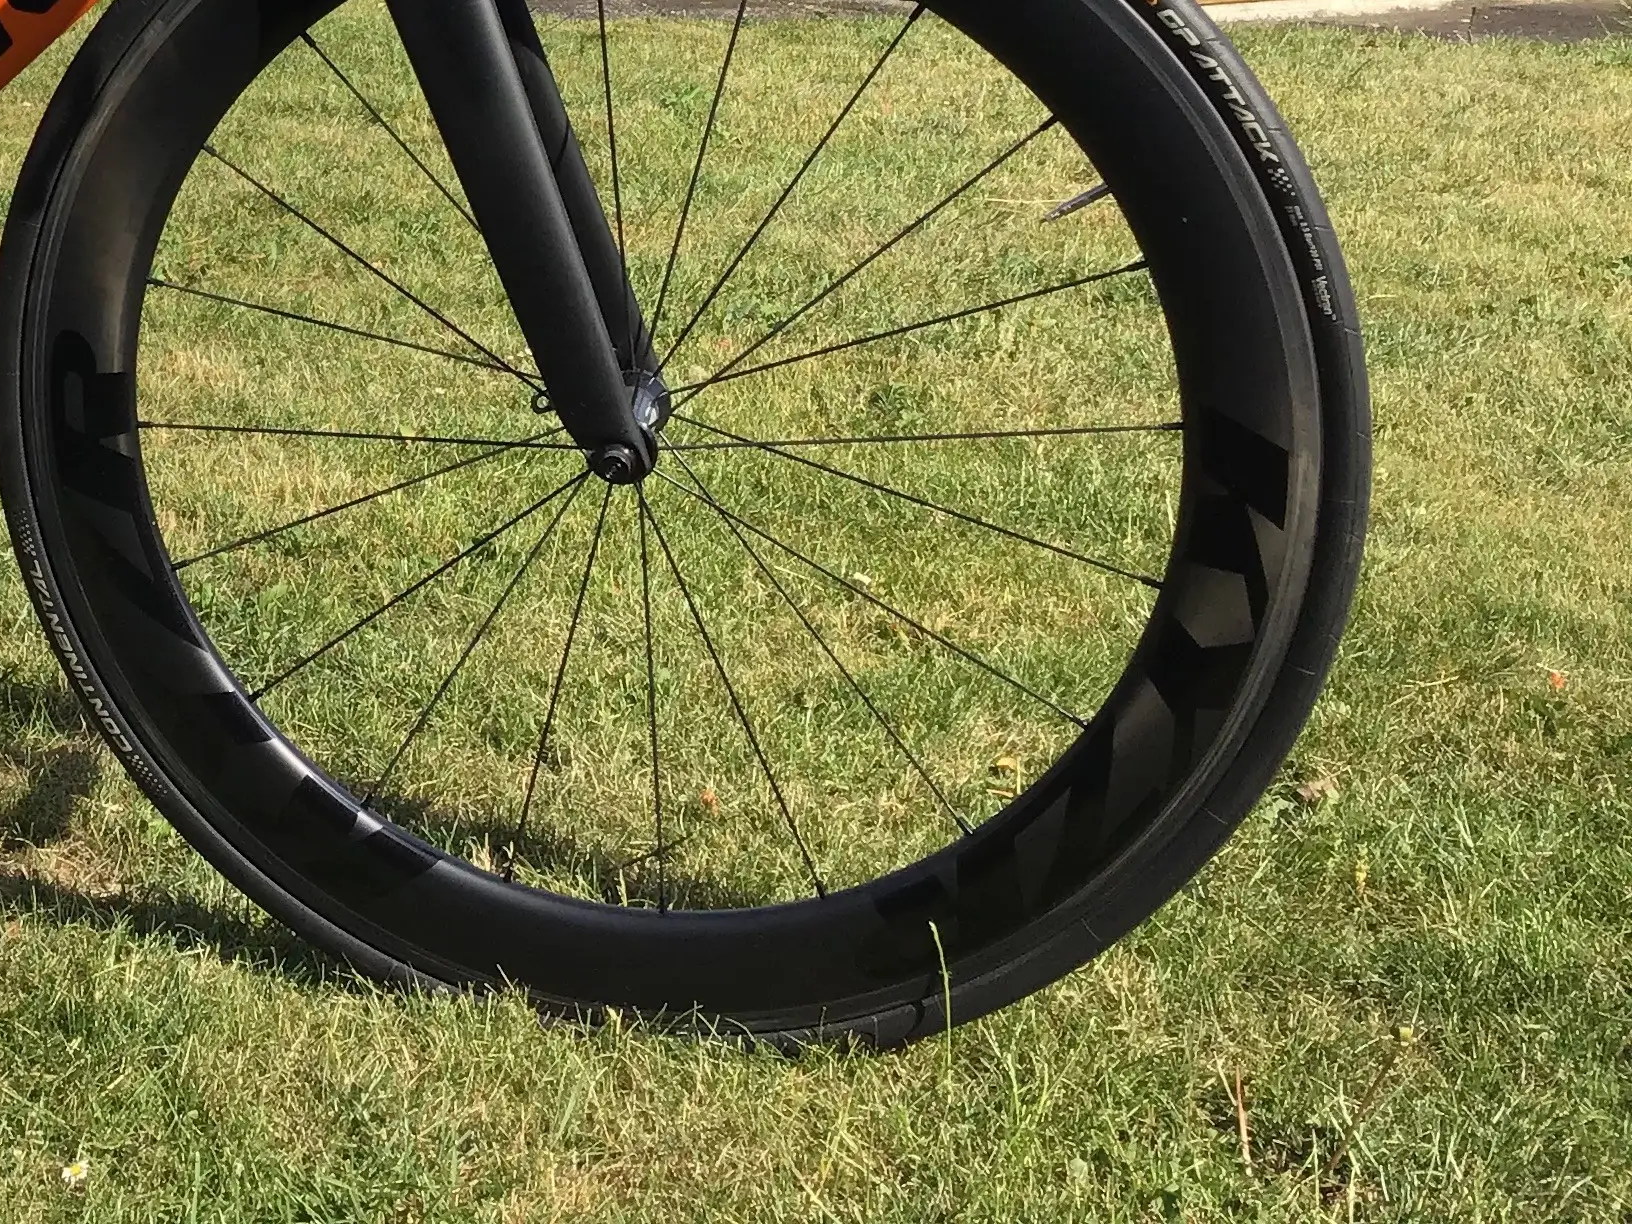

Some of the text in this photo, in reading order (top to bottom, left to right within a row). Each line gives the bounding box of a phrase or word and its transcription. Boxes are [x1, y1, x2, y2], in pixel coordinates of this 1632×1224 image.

[1156, 7, 1280, 164] GP ATTACK
[29, 558, 134, 753] CONTINENTAL
